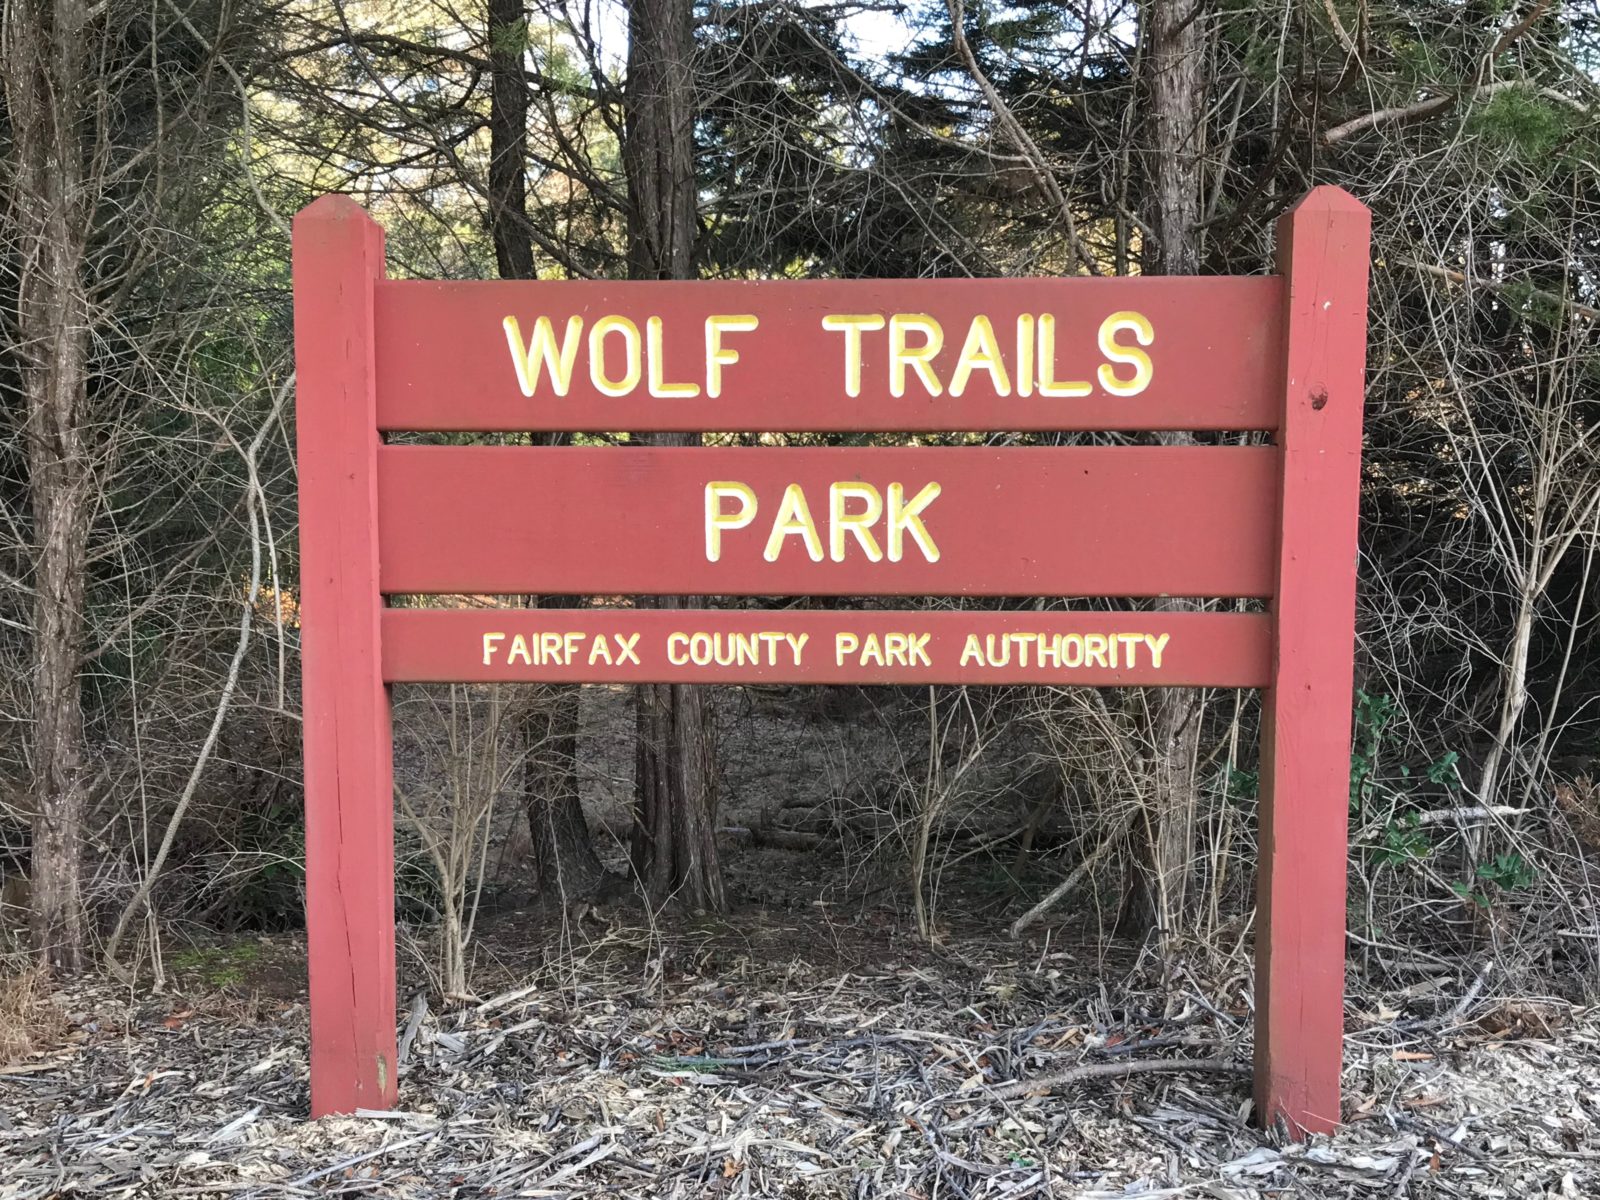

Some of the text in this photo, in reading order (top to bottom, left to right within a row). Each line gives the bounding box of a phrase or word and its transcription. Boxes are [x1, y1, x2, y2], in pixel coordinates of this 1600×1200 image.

[502, 311, 1155, 399] WOLF TRAILS
[704, 480, 942, 564] PARK
[482, 631, 1171, 670] FAIRFAX COUNTY PARK AUTHORITY
